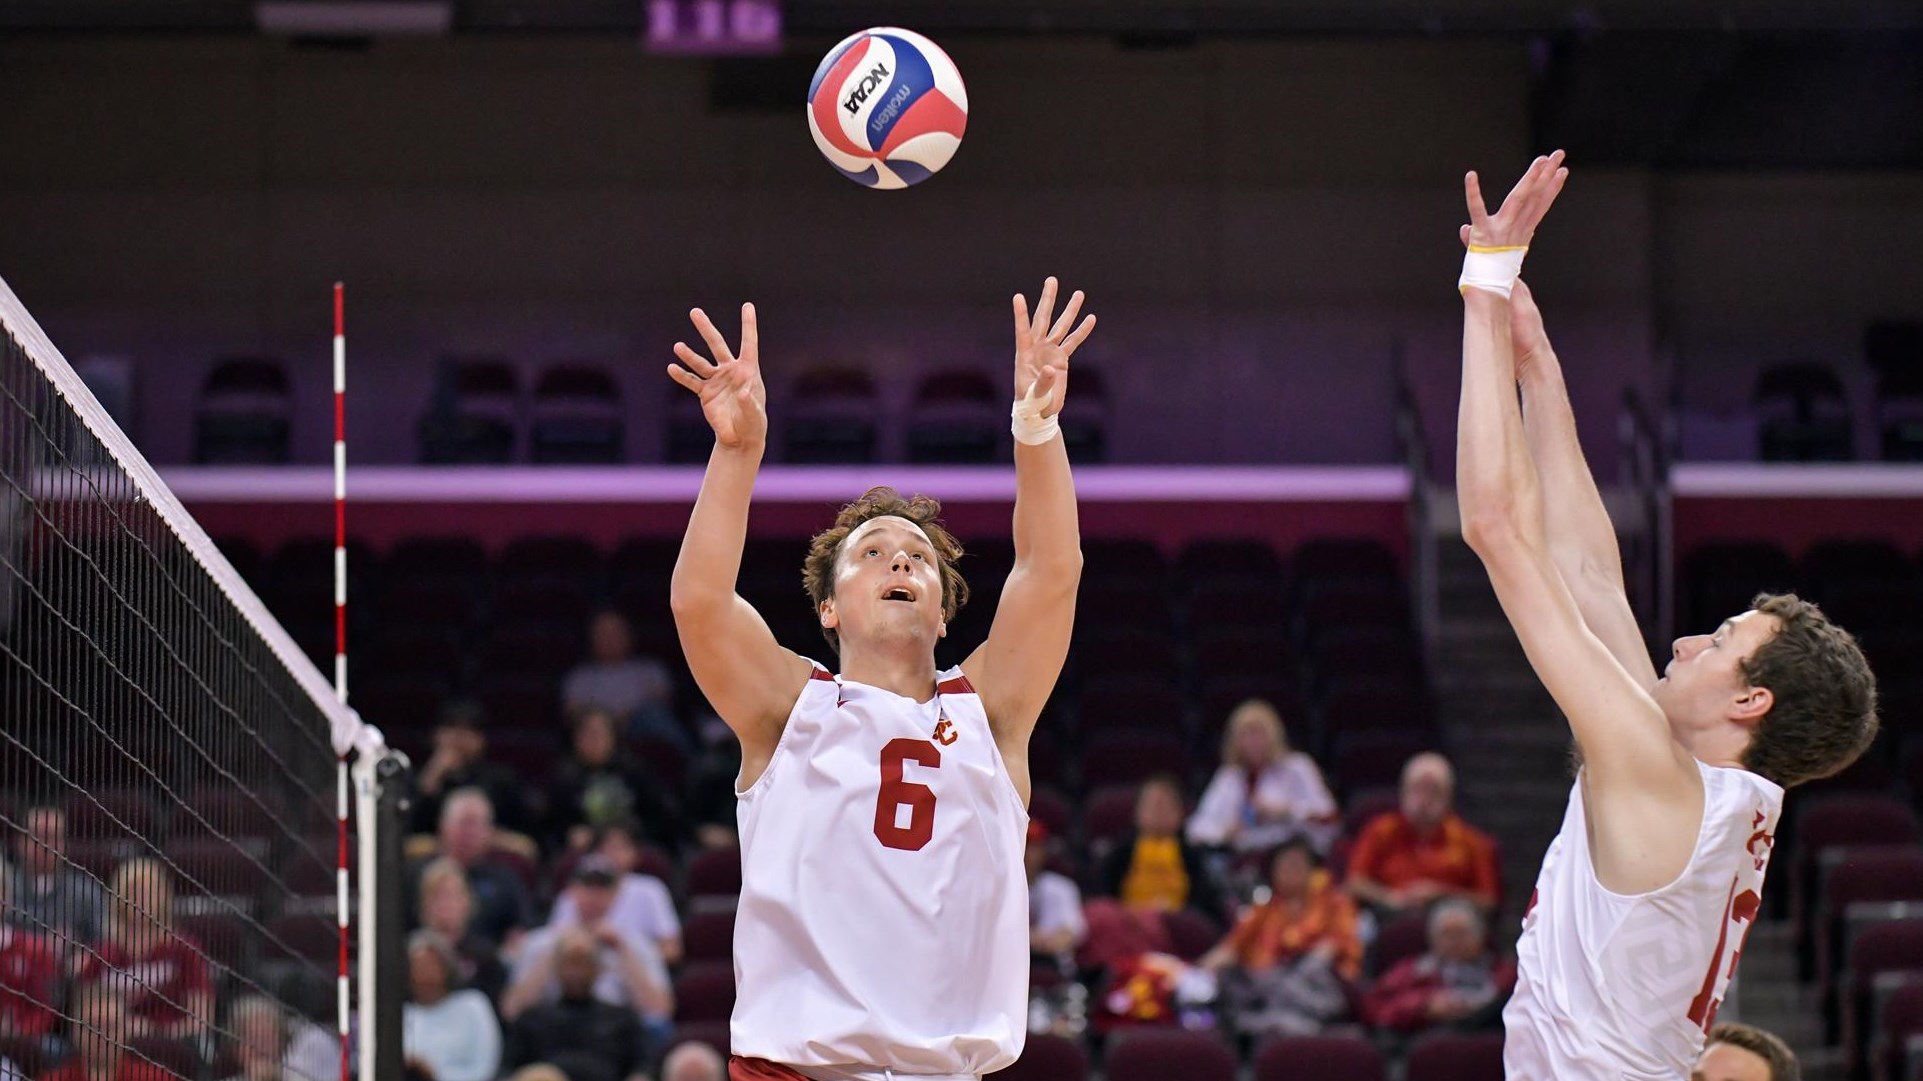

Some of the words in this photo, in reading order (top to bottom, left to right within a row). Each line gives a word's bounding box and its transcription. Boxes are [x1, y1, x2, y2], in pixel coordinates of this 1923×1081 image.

[844, 62, 890, 115] NCAA
[871, 84, 911, 131] molten
[873, 738, 941, 851] 6
